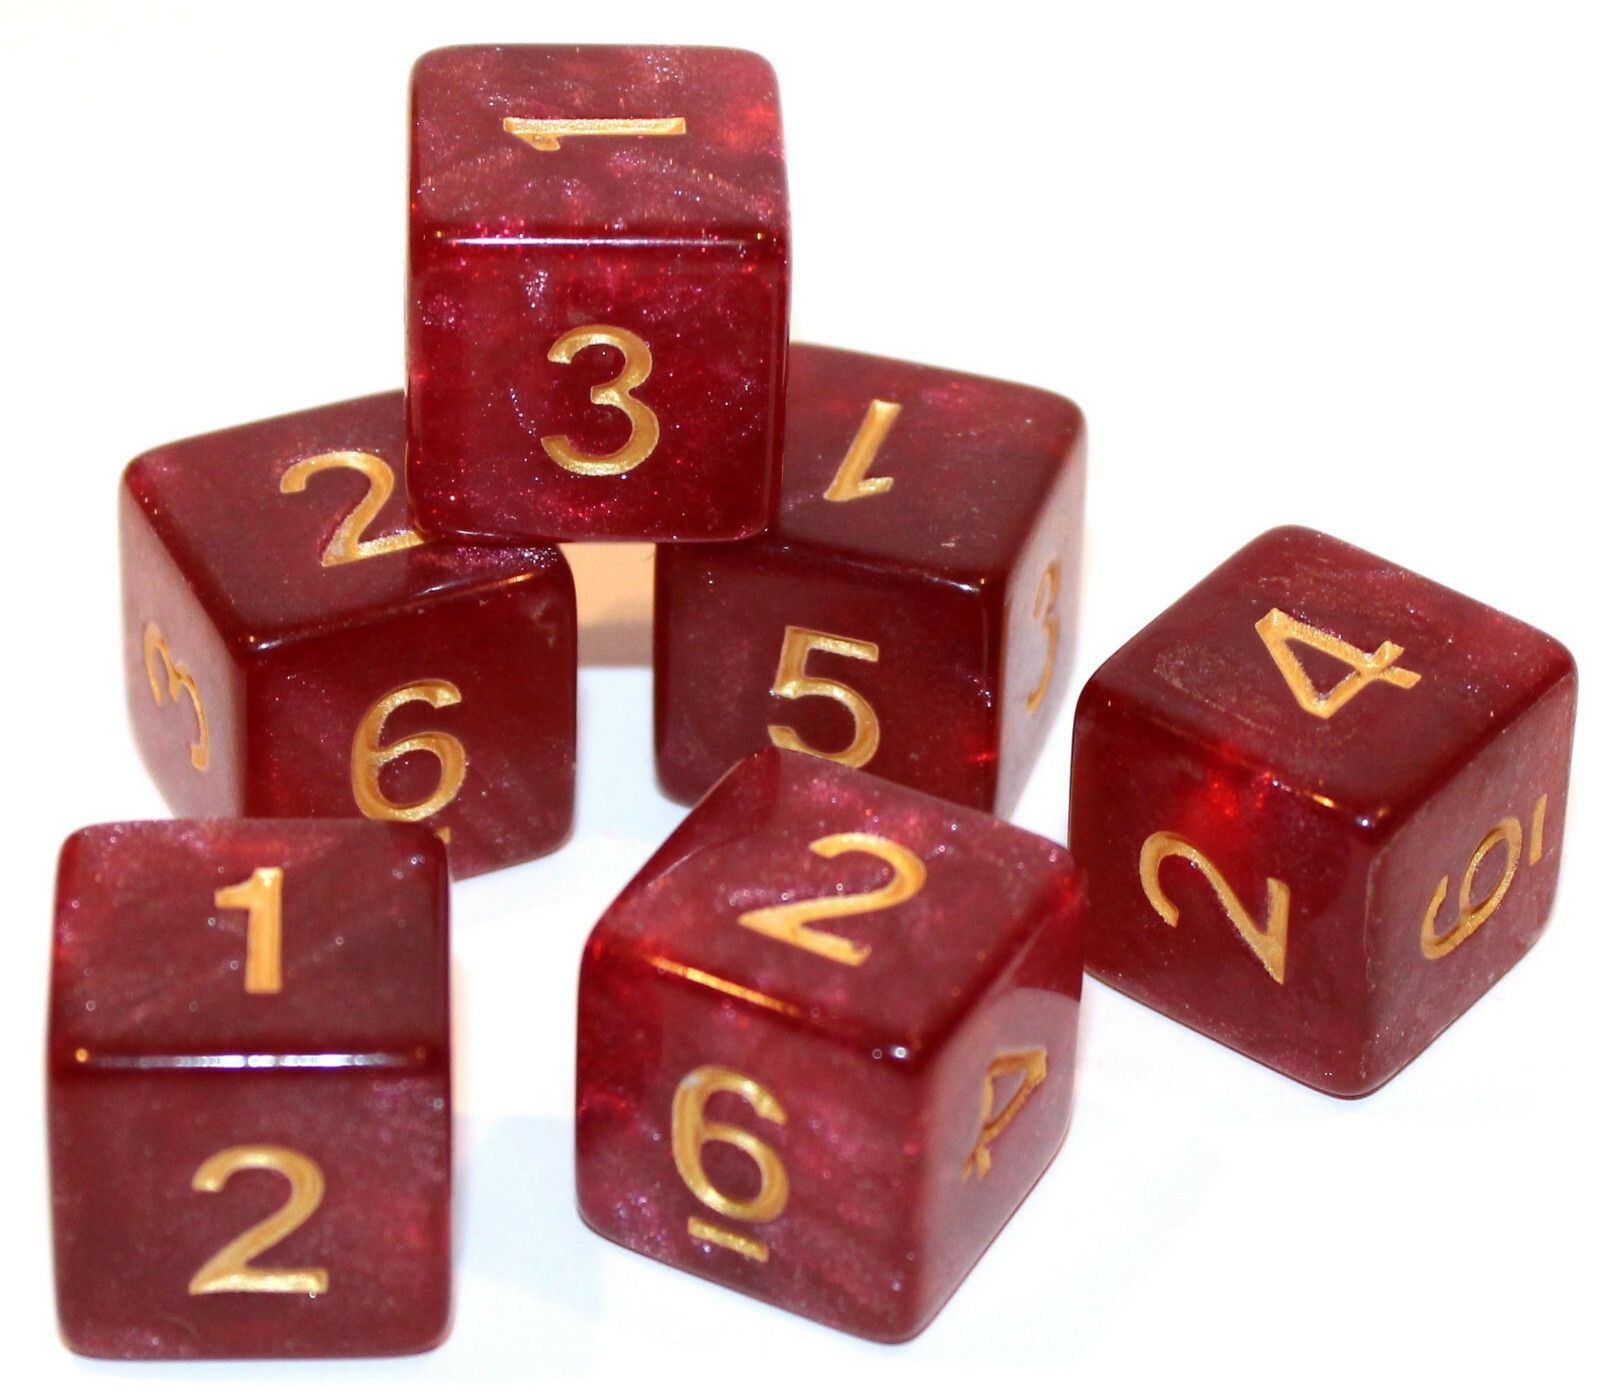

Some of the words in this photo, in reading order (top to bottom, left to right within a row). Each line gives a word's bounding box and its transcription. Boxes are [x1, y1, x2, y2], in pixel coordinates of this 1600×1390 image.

[504, 117, 687, 152] 1
[542, 325, 661, 477] 3
[824, 399, 901, 502] 1
[280, 450, 427, 568] 2
[144, 622, 210, 771] 3
[767, 625, 881, 769] 5
[1027, 559, 1061, 716] 3
[1255, 607, 1423, 721] 4
[351, 678, 468, 822] 6
[215, 867, 285, 994] 1
[738, 833, 928, 967] 2
[1139, 831, 1291, 985] 2
[1421, 815, 1524, 961] 6
[671, 1067, 790, 1224] 6
[963, 1046, 1048, 1181] 4
[190, 1144, 330, 1296] 2
